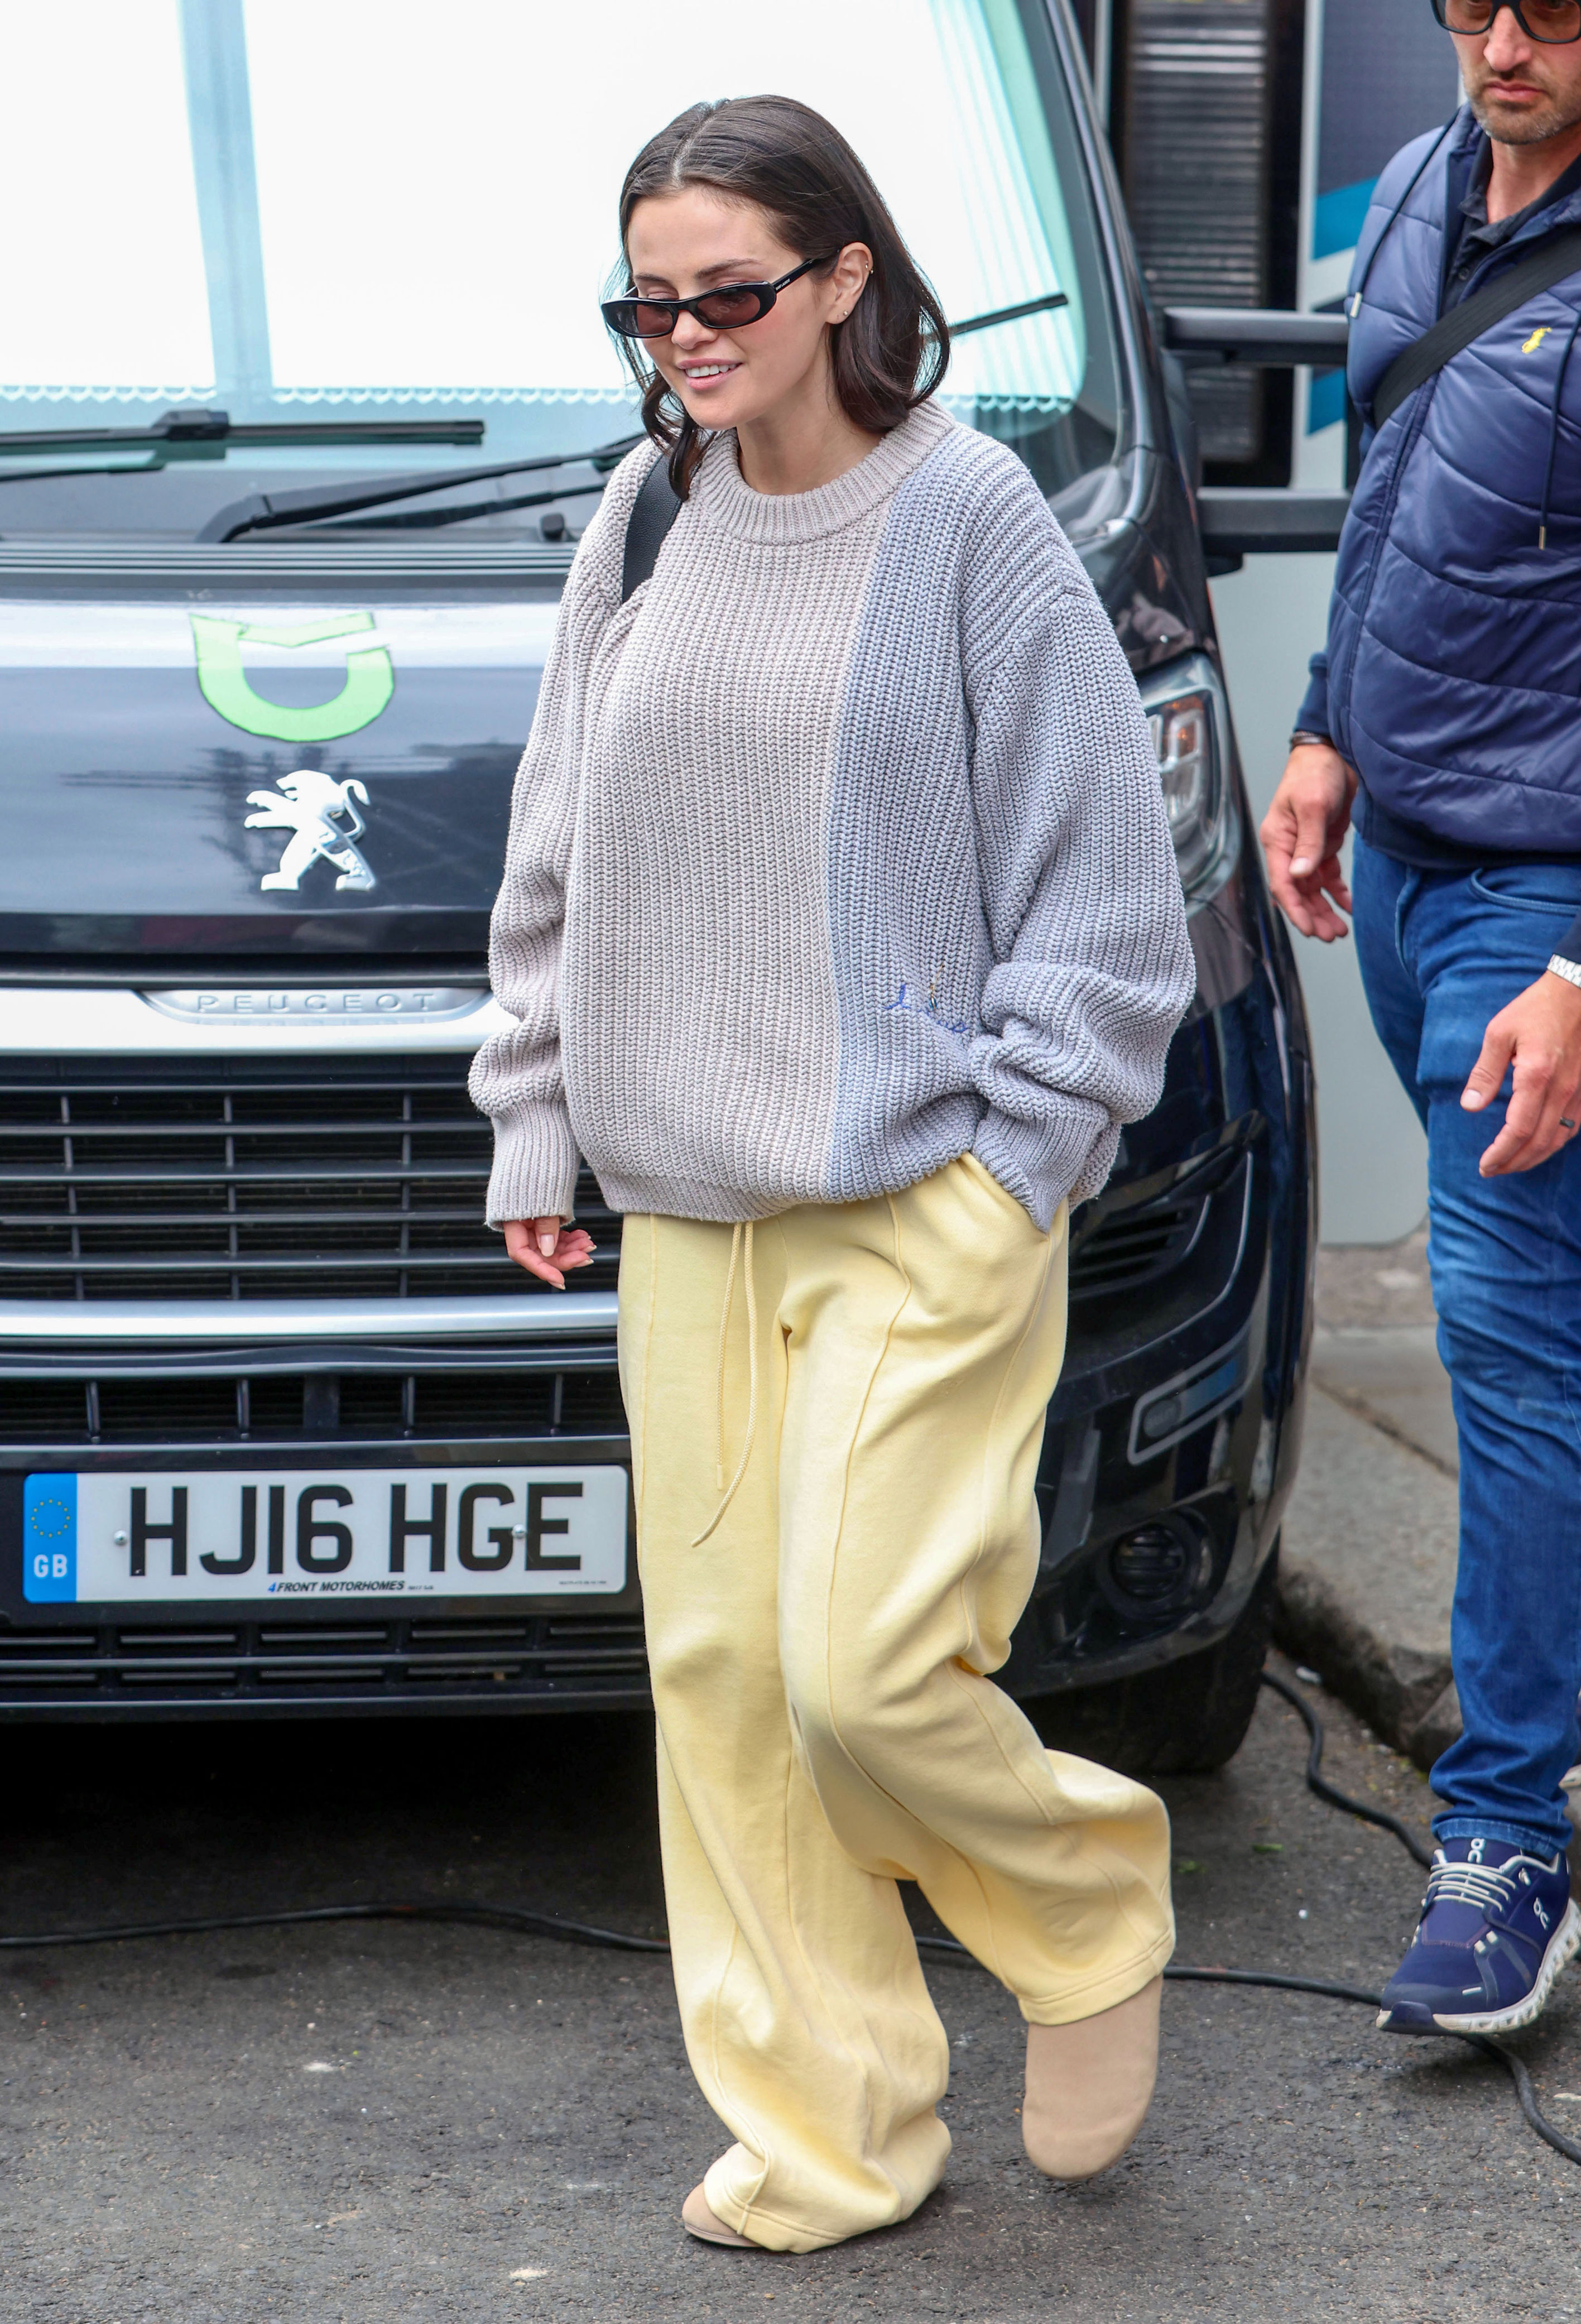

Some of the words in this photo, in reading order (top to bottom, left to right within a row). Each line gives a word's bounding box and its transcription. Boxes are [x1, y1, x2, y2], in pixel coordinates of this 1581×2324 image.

[197, 993, 436, 1012] PEUGEOT
[131, 1485, 353, 1577] HJ16
[390, 1482, 583, 1573] HGE
[33, 1553, 68, 1578] GB
[319, 1580, 405, 1592] MOTORHOMES
